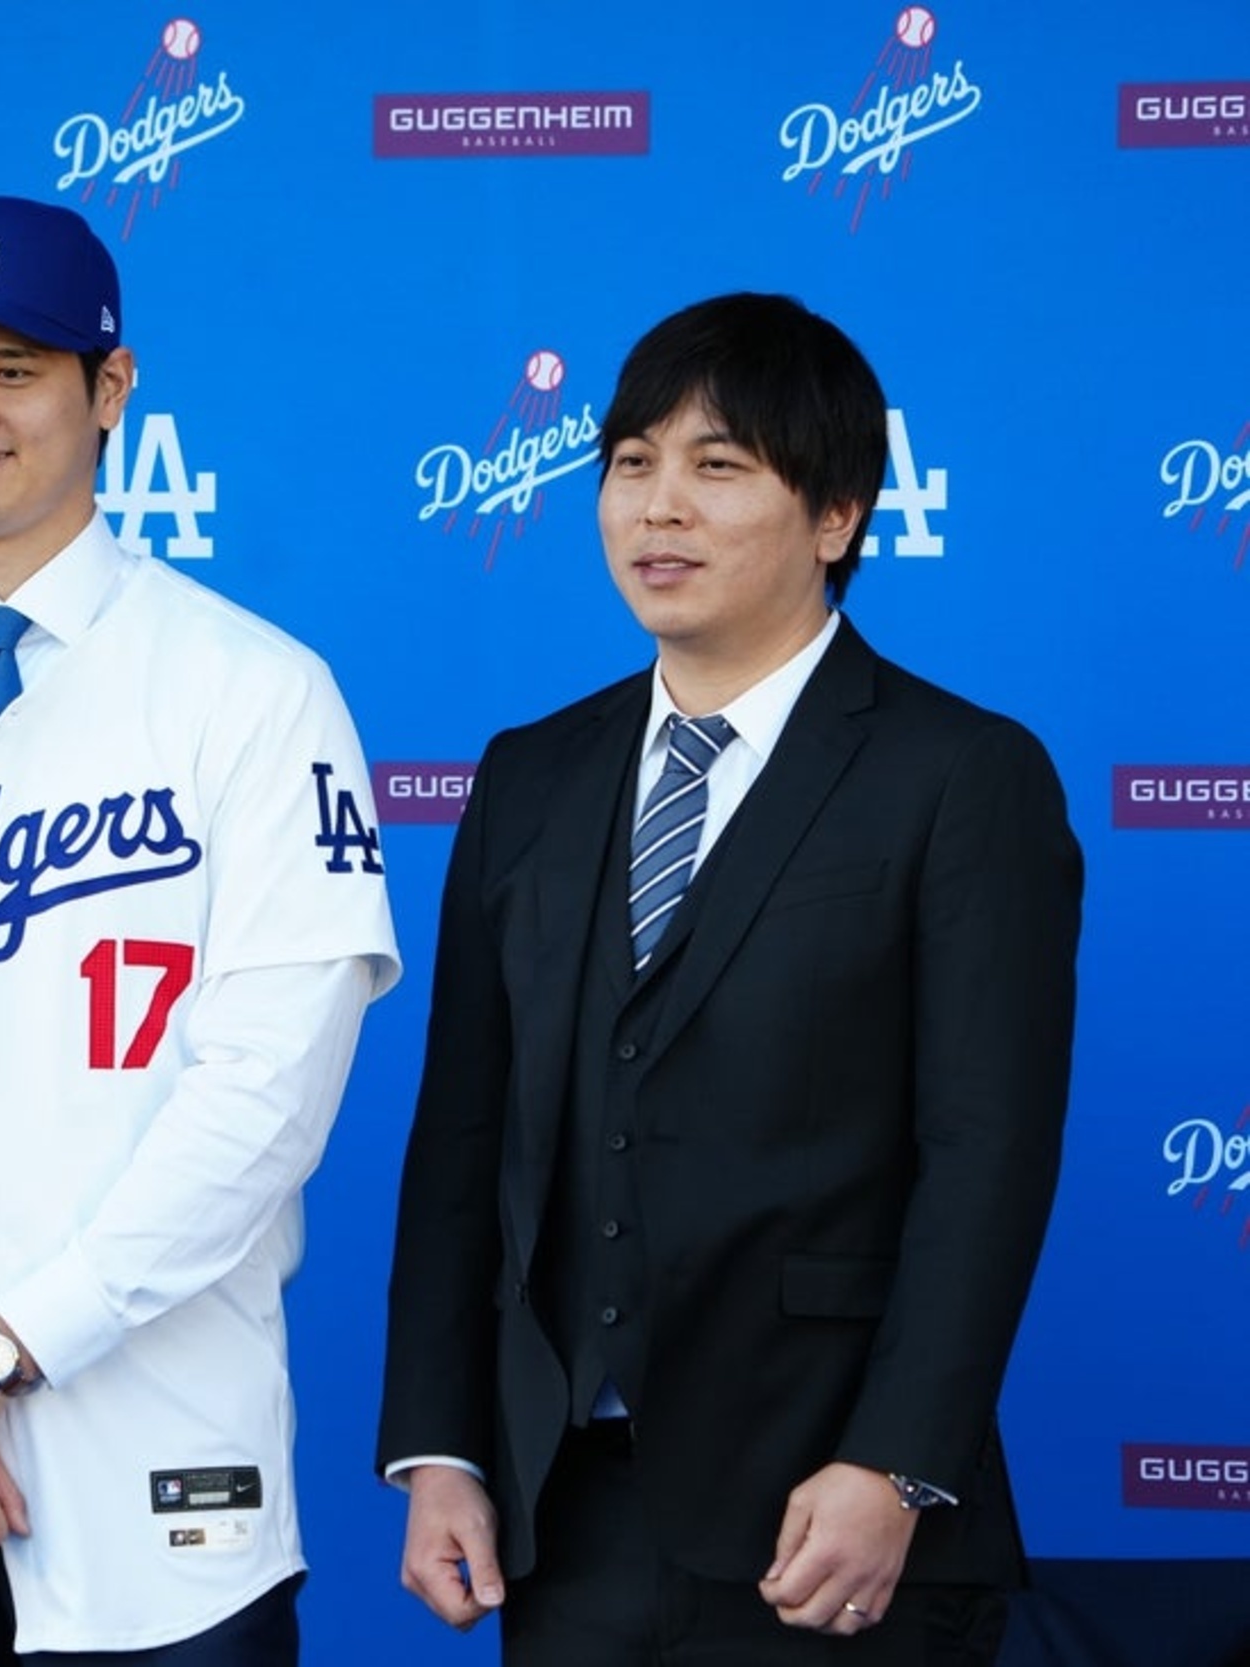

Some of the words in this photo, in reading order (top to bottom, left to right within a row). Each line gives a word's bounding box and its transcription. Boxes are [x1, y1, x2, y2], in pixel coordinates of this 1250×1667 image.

[54, 71, 244, 191] Dodgers
[390, 106, 632, 131] GUGGENHEIM
[780, 60, 981, 182] Dodgers
[415, 403, 601, 521] Dodgers
[312, 762, 385, 875] LA
[80, 939, 195, 1070] 17
